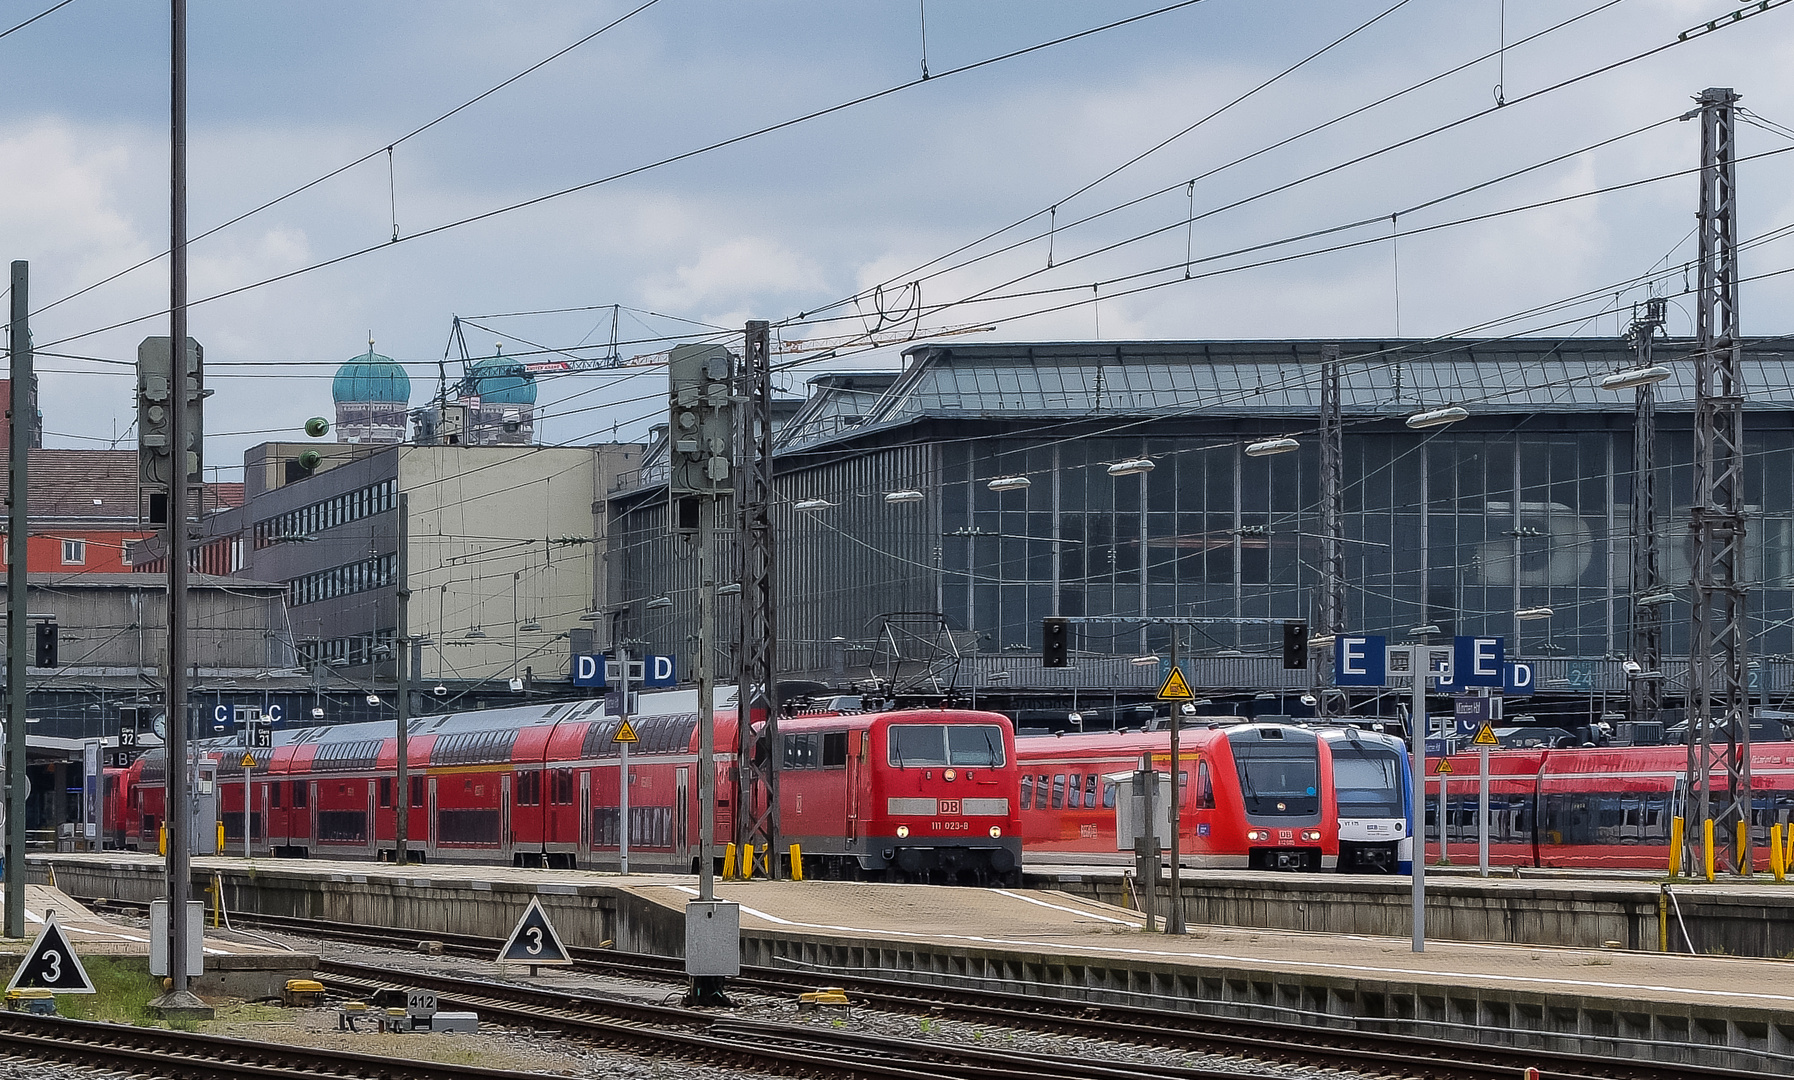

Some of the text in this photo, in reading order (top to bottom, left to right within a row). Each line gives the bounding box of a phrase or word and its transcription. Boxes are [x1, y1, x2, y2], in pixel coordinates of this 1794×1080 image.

[1343, 638, 1366, 675] E
[1474, 639, 1497, 675] E
[579, 656, 596, 679] D
[655, 656, 672, 680] D
[1514, 664, 1531, 687] D
[1572, 669, 1592, 686] 24
[215, 705, 227, 722] C
[268, 705, 282, 721] C
[122, 733, 133, 745] 32
[259, 735, 269, 746] 31
[118, 752, 128, 766] B
[941, 801, 958, 812] DB
[931, 822, 969, 830] 111 023-8
[525, 927, 543, 955] 3
[41, 949, 61, 983] 3
[410, 996, 434, 1009] 412
